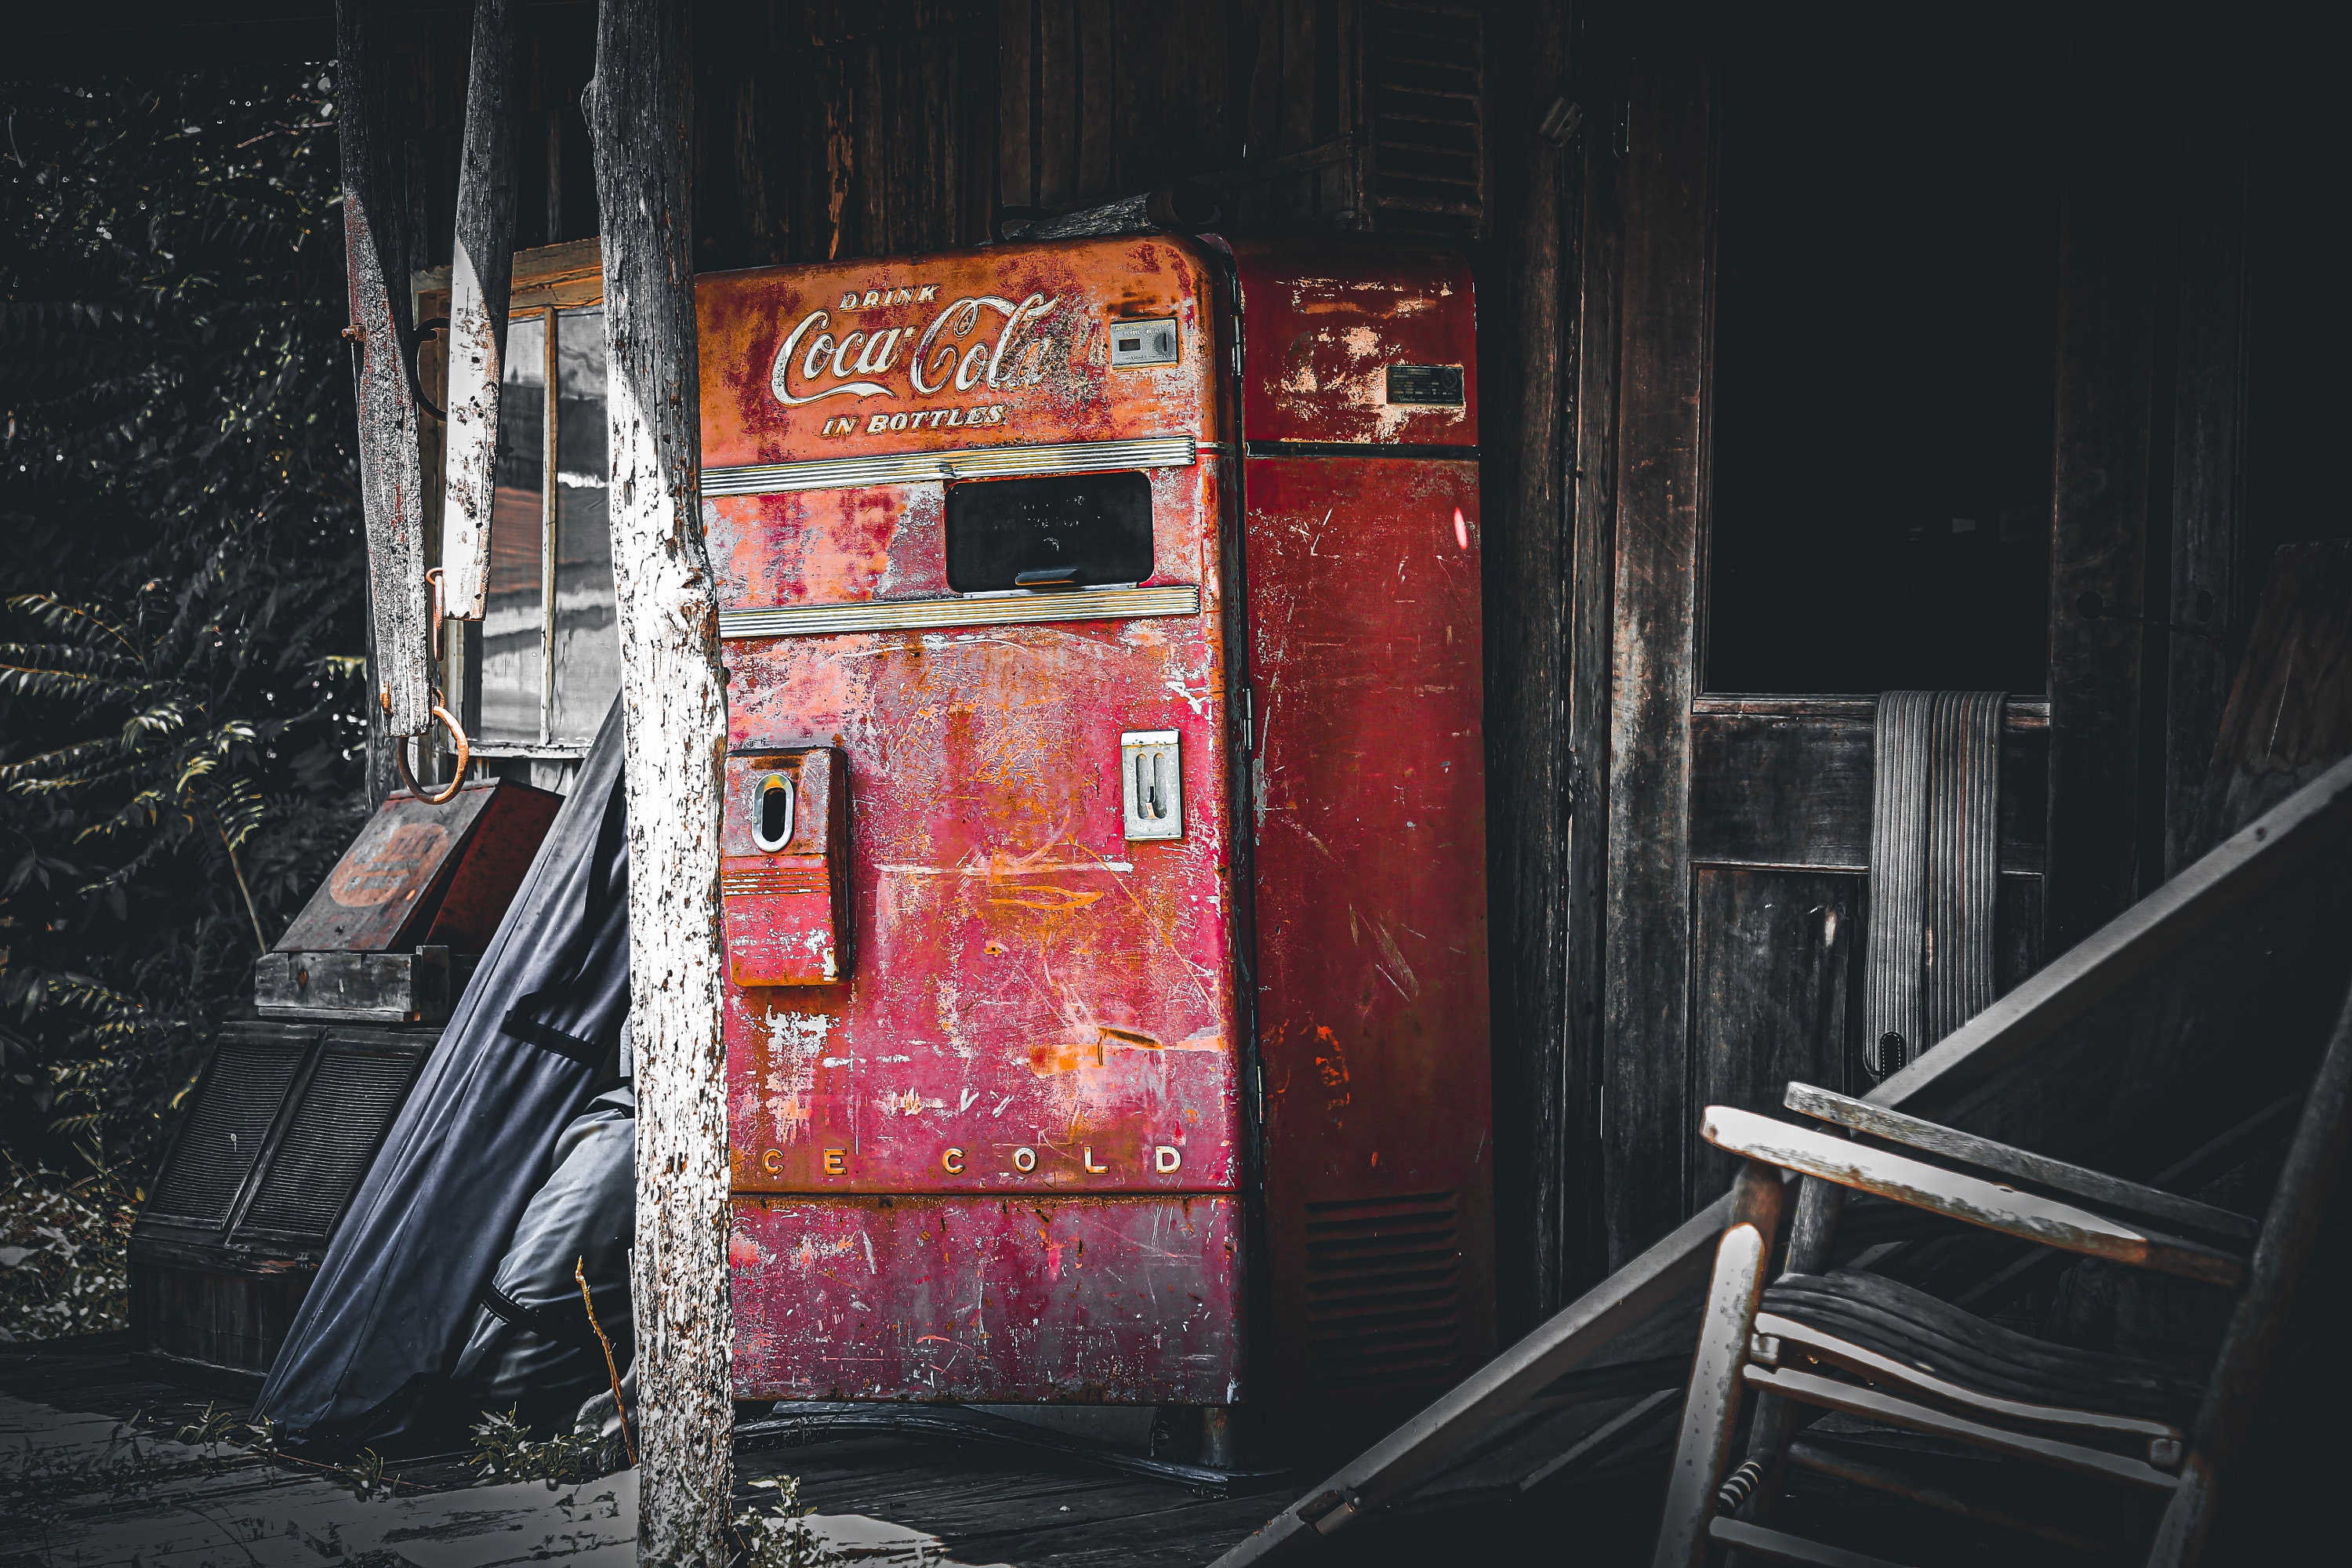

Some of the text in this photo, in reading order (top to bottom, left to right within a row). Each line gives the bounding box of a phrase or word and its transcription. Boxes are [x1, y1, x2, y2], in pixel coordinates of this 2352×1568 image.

[838, 285, 940, 312] DRINK
[771, 291, 1065, 406] Coca-Cola
[820, 404, 1007, 437] IN BOTTLES
[762, 1146, 1183, 1175] CE COLD
